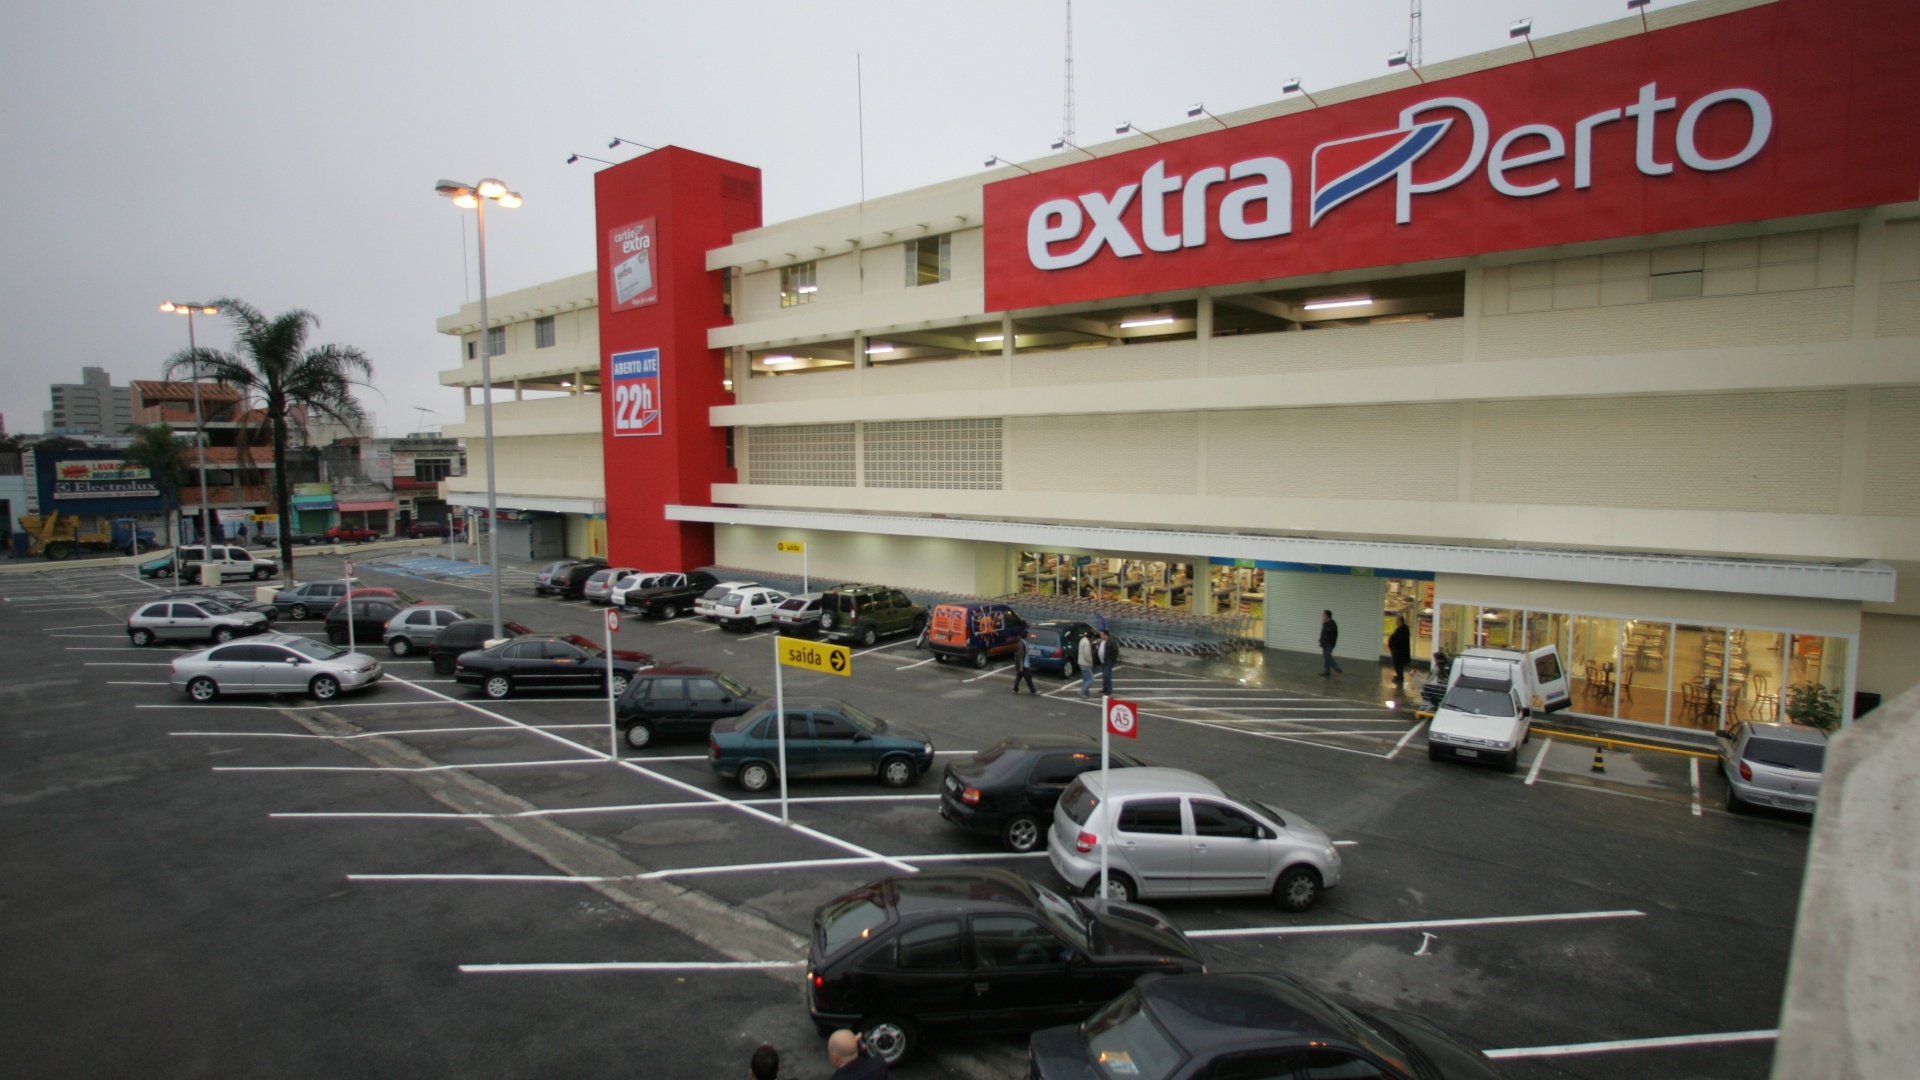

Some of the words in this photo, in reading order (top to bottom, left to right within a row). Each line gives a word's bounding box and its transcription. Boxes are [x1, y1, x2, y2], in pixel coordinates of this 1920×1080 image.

[1027, 156, 1292, 271] extra
[1395, 81, 1773, 224] Perto
[614, 228, 635, 243] cartão
[623, 235, 650, 253] extra
[614, 360, 642, 375] ABERTO
[643, 355, 657, 372] ATÉ
[616, 383, 652, 429] 22h
[74, 481, 156, 492] Electrolux
[789, 647, 822, 665] saída
[1114, 711, 1130, 726] A5
